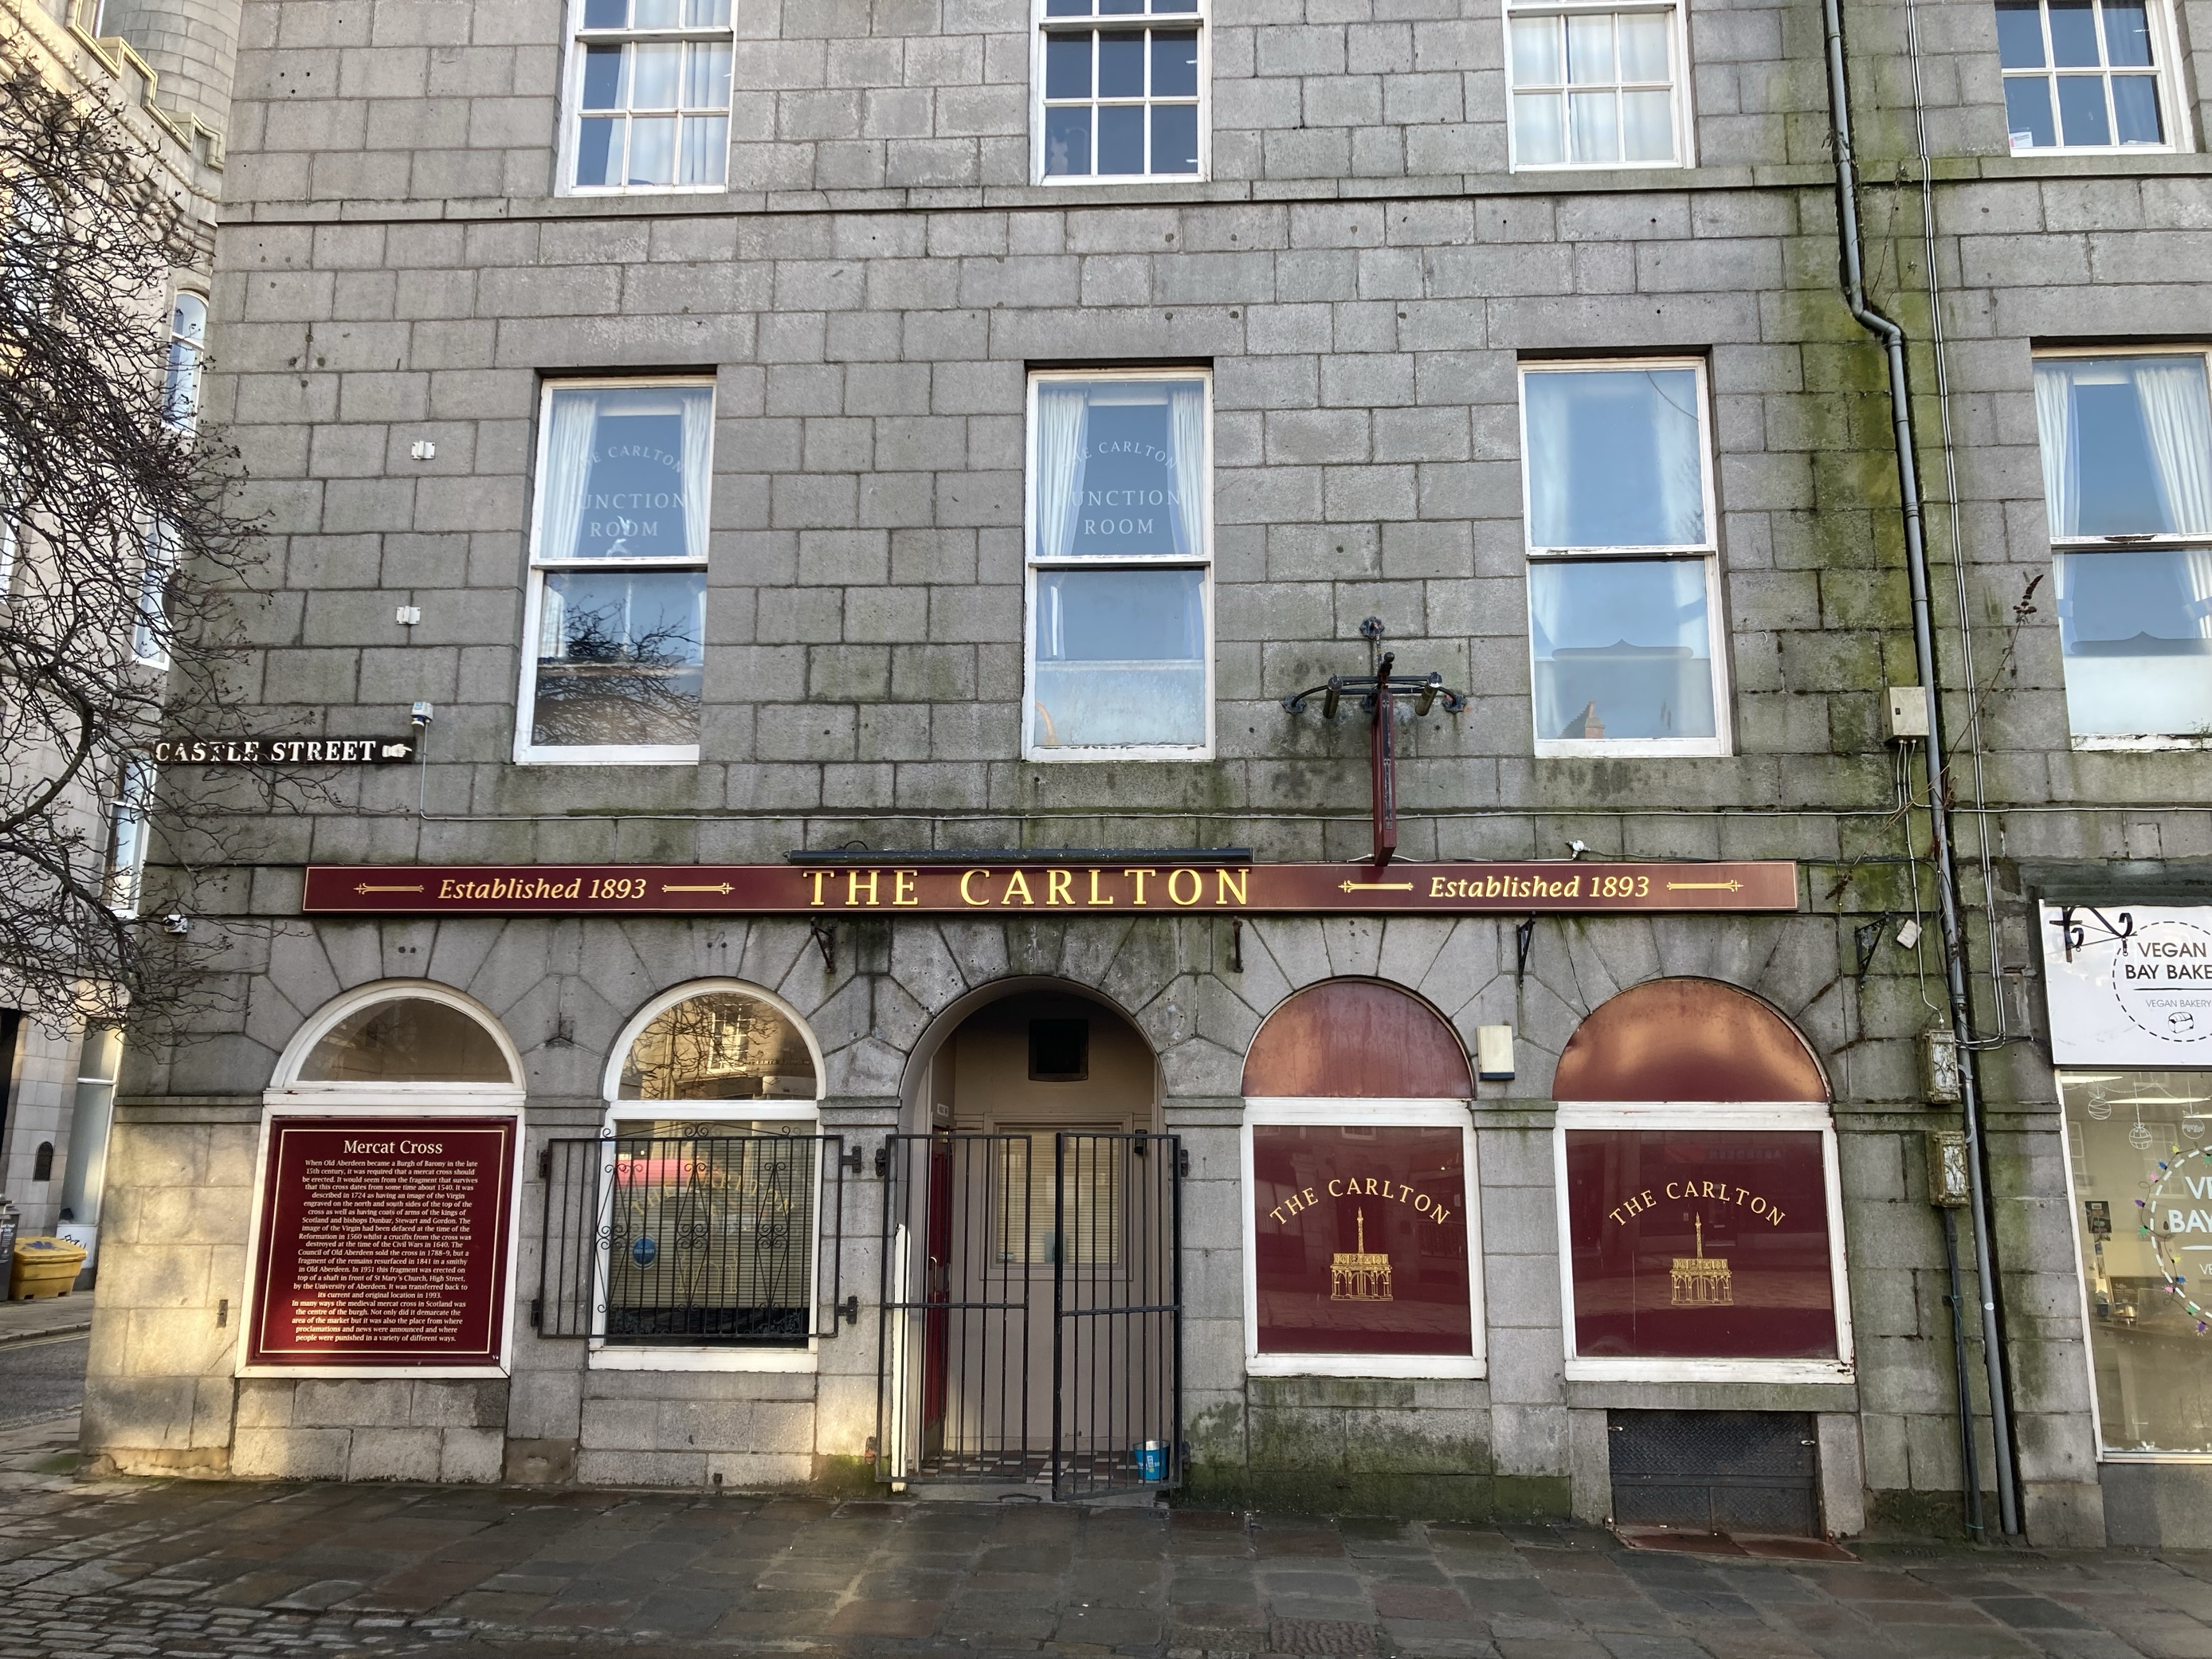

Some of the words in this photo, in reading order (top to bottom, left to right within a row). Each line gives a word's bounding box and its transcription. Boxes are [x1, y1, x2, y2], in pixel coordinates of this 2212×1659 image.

[608, 445, 685, 473] CARLTON
[1098, 441, 1178, 469] CARLTON
[578, 492, 686, 510] UNCTION
[1071, 490, 1180, 507] UNCTION
[589, 521, 659, 537] ROOM
[1084, 518, 1154, 535] ROOM
[155, 741, 259, 762] CASTLE
[271, 740, 376, 762] STREET
[437, 878, 579, 900] Established
[588, 878, 646, 900] 1893
[802, 869, 919, 906] THE
[960, 869, 1249, 907] CARLTON
[1429, 875, 1579, 898] Established
[1590, 876, 1649, 898] 1893
[2138, 942, 2206, 958] VEGAN
[2125, 964, 2159, 980] BAY
[2167, 964, 2212, 979] BAKE
[2179, 999, 2211, 1008] BAKERY
[343, 1139, 396, 1154] Mercat
[400, 1139, 443, 1154] Cross
[1269, 1187, 1319, 1225] THE
[1328, 1178, 1450, 1225] CARLTON
[1609, 1190, 1657, 1226] THE
[1666, 1181, 1786, 1226] CARLTON
